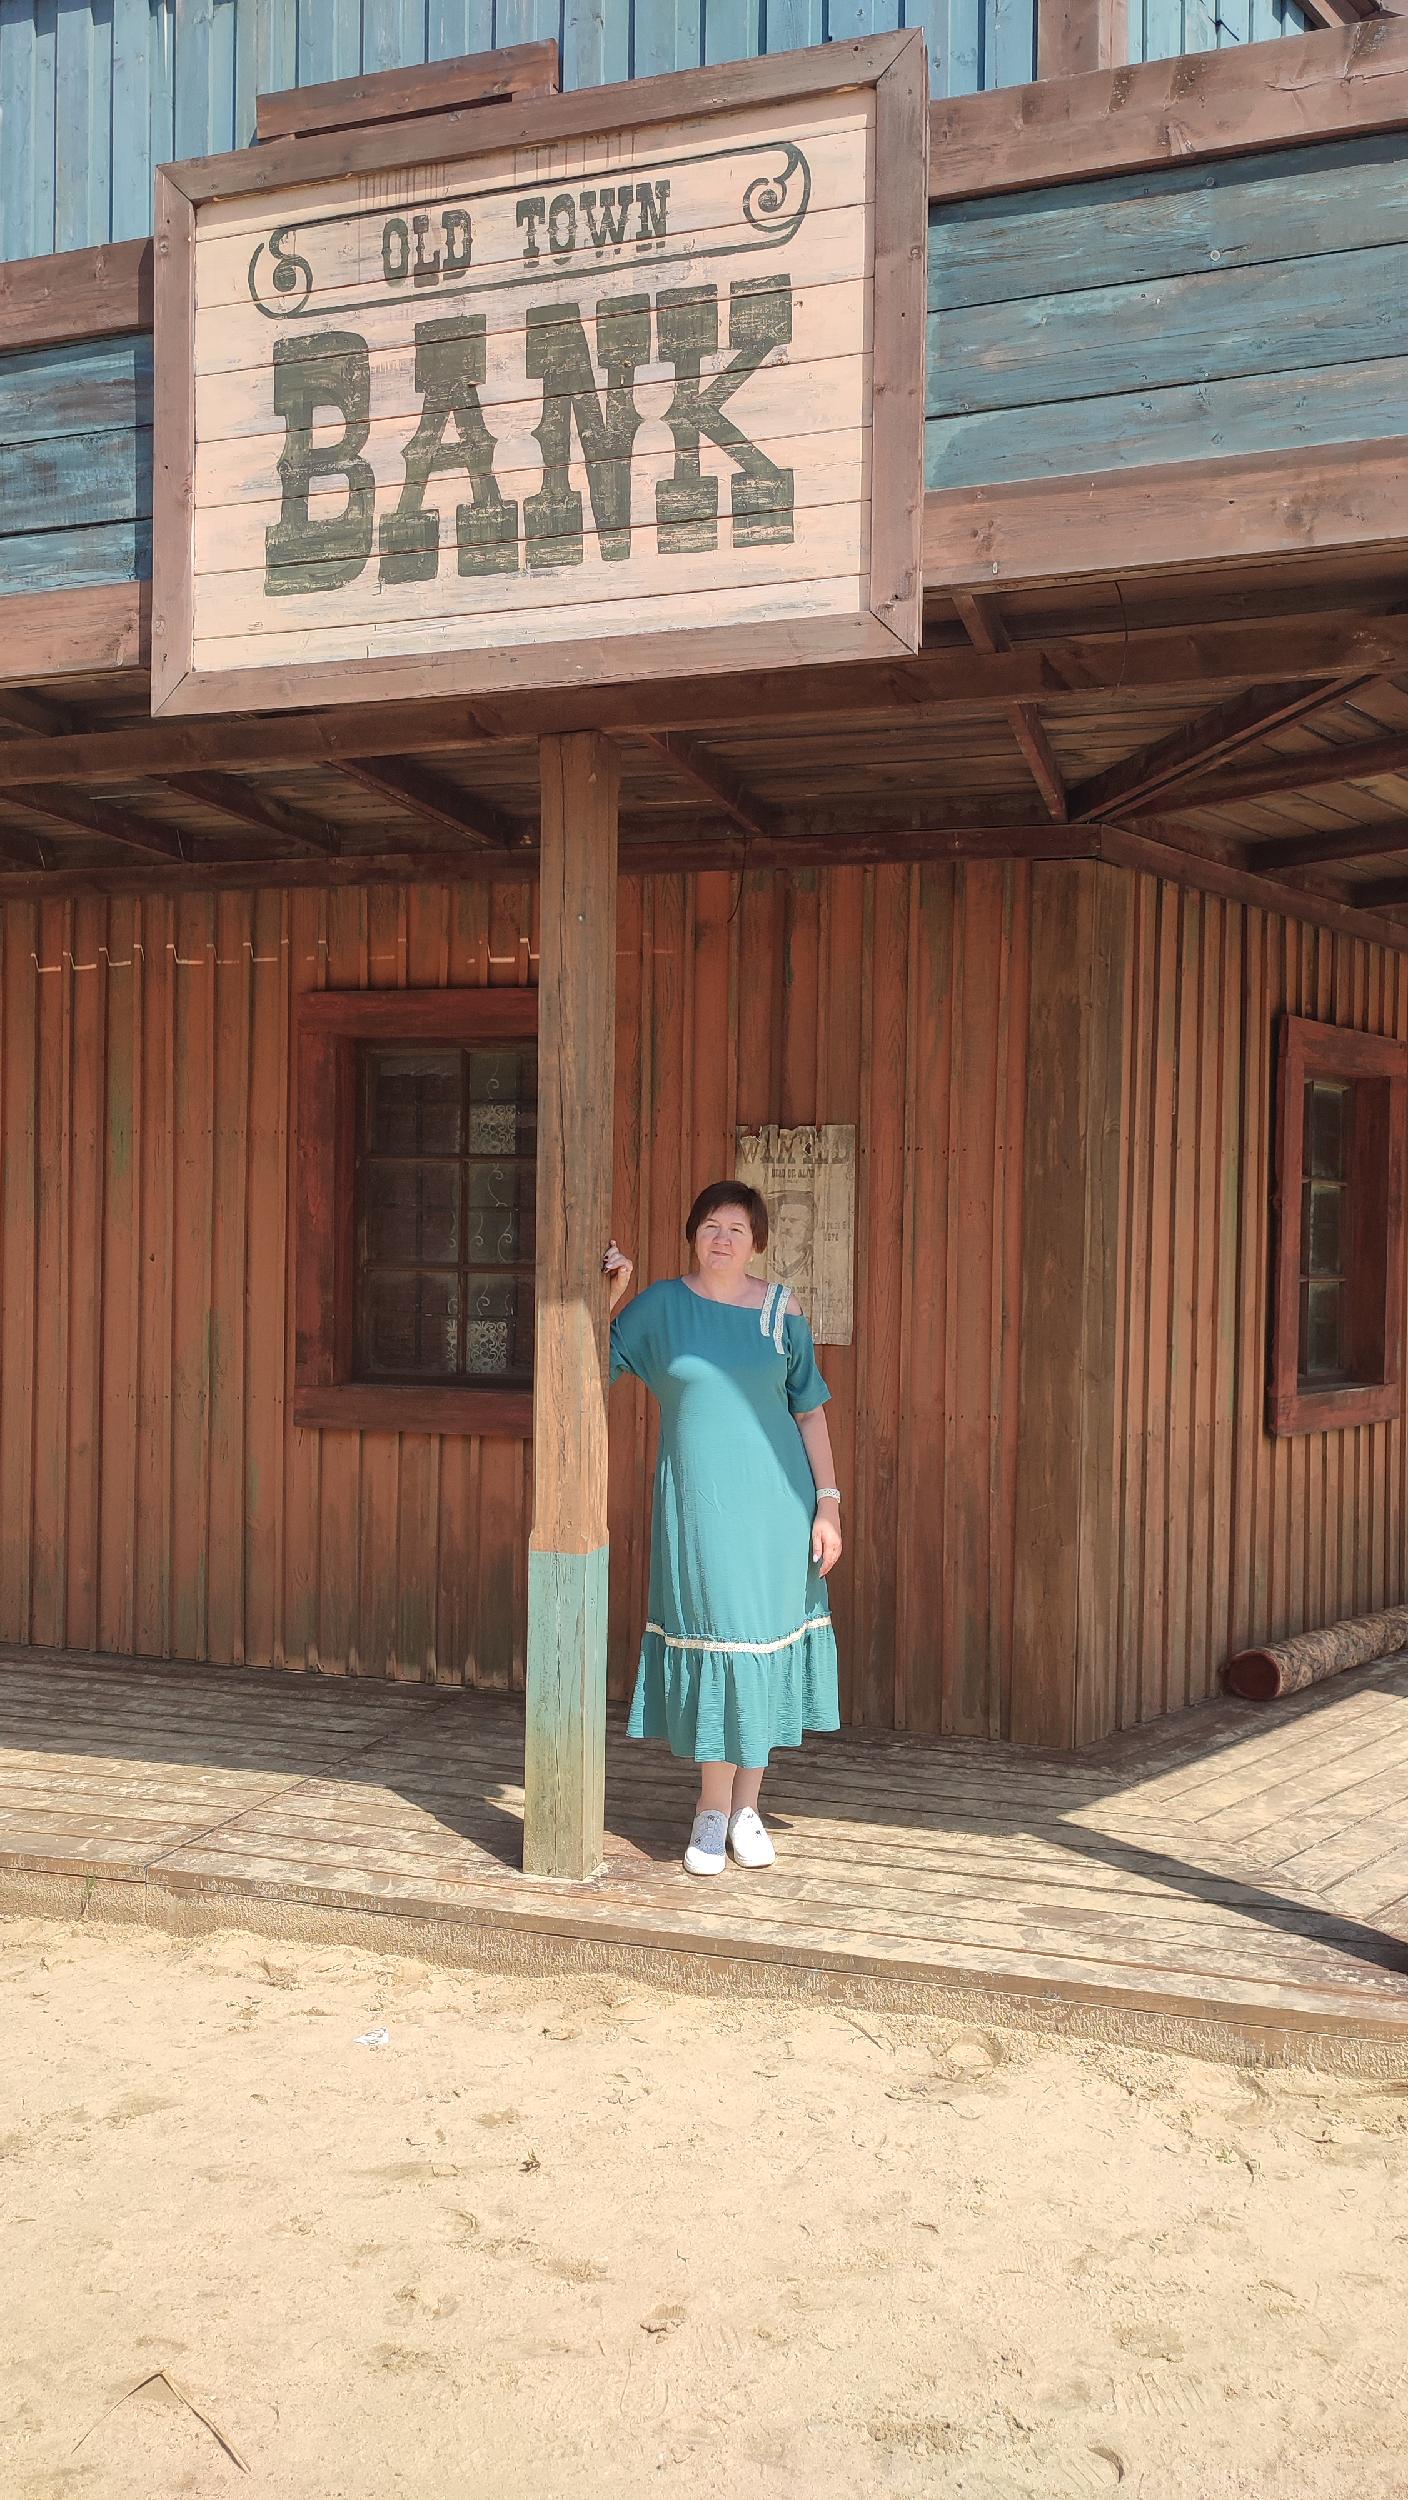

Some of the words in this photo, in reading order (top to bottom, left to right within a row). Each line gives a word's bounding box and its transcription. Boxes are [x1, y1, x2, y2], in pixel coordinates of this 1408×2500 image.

[381, 208, 473, 289] OLD
[515, 179, 671, 269] TOWN
[264, 272, 795, 597] BANK
